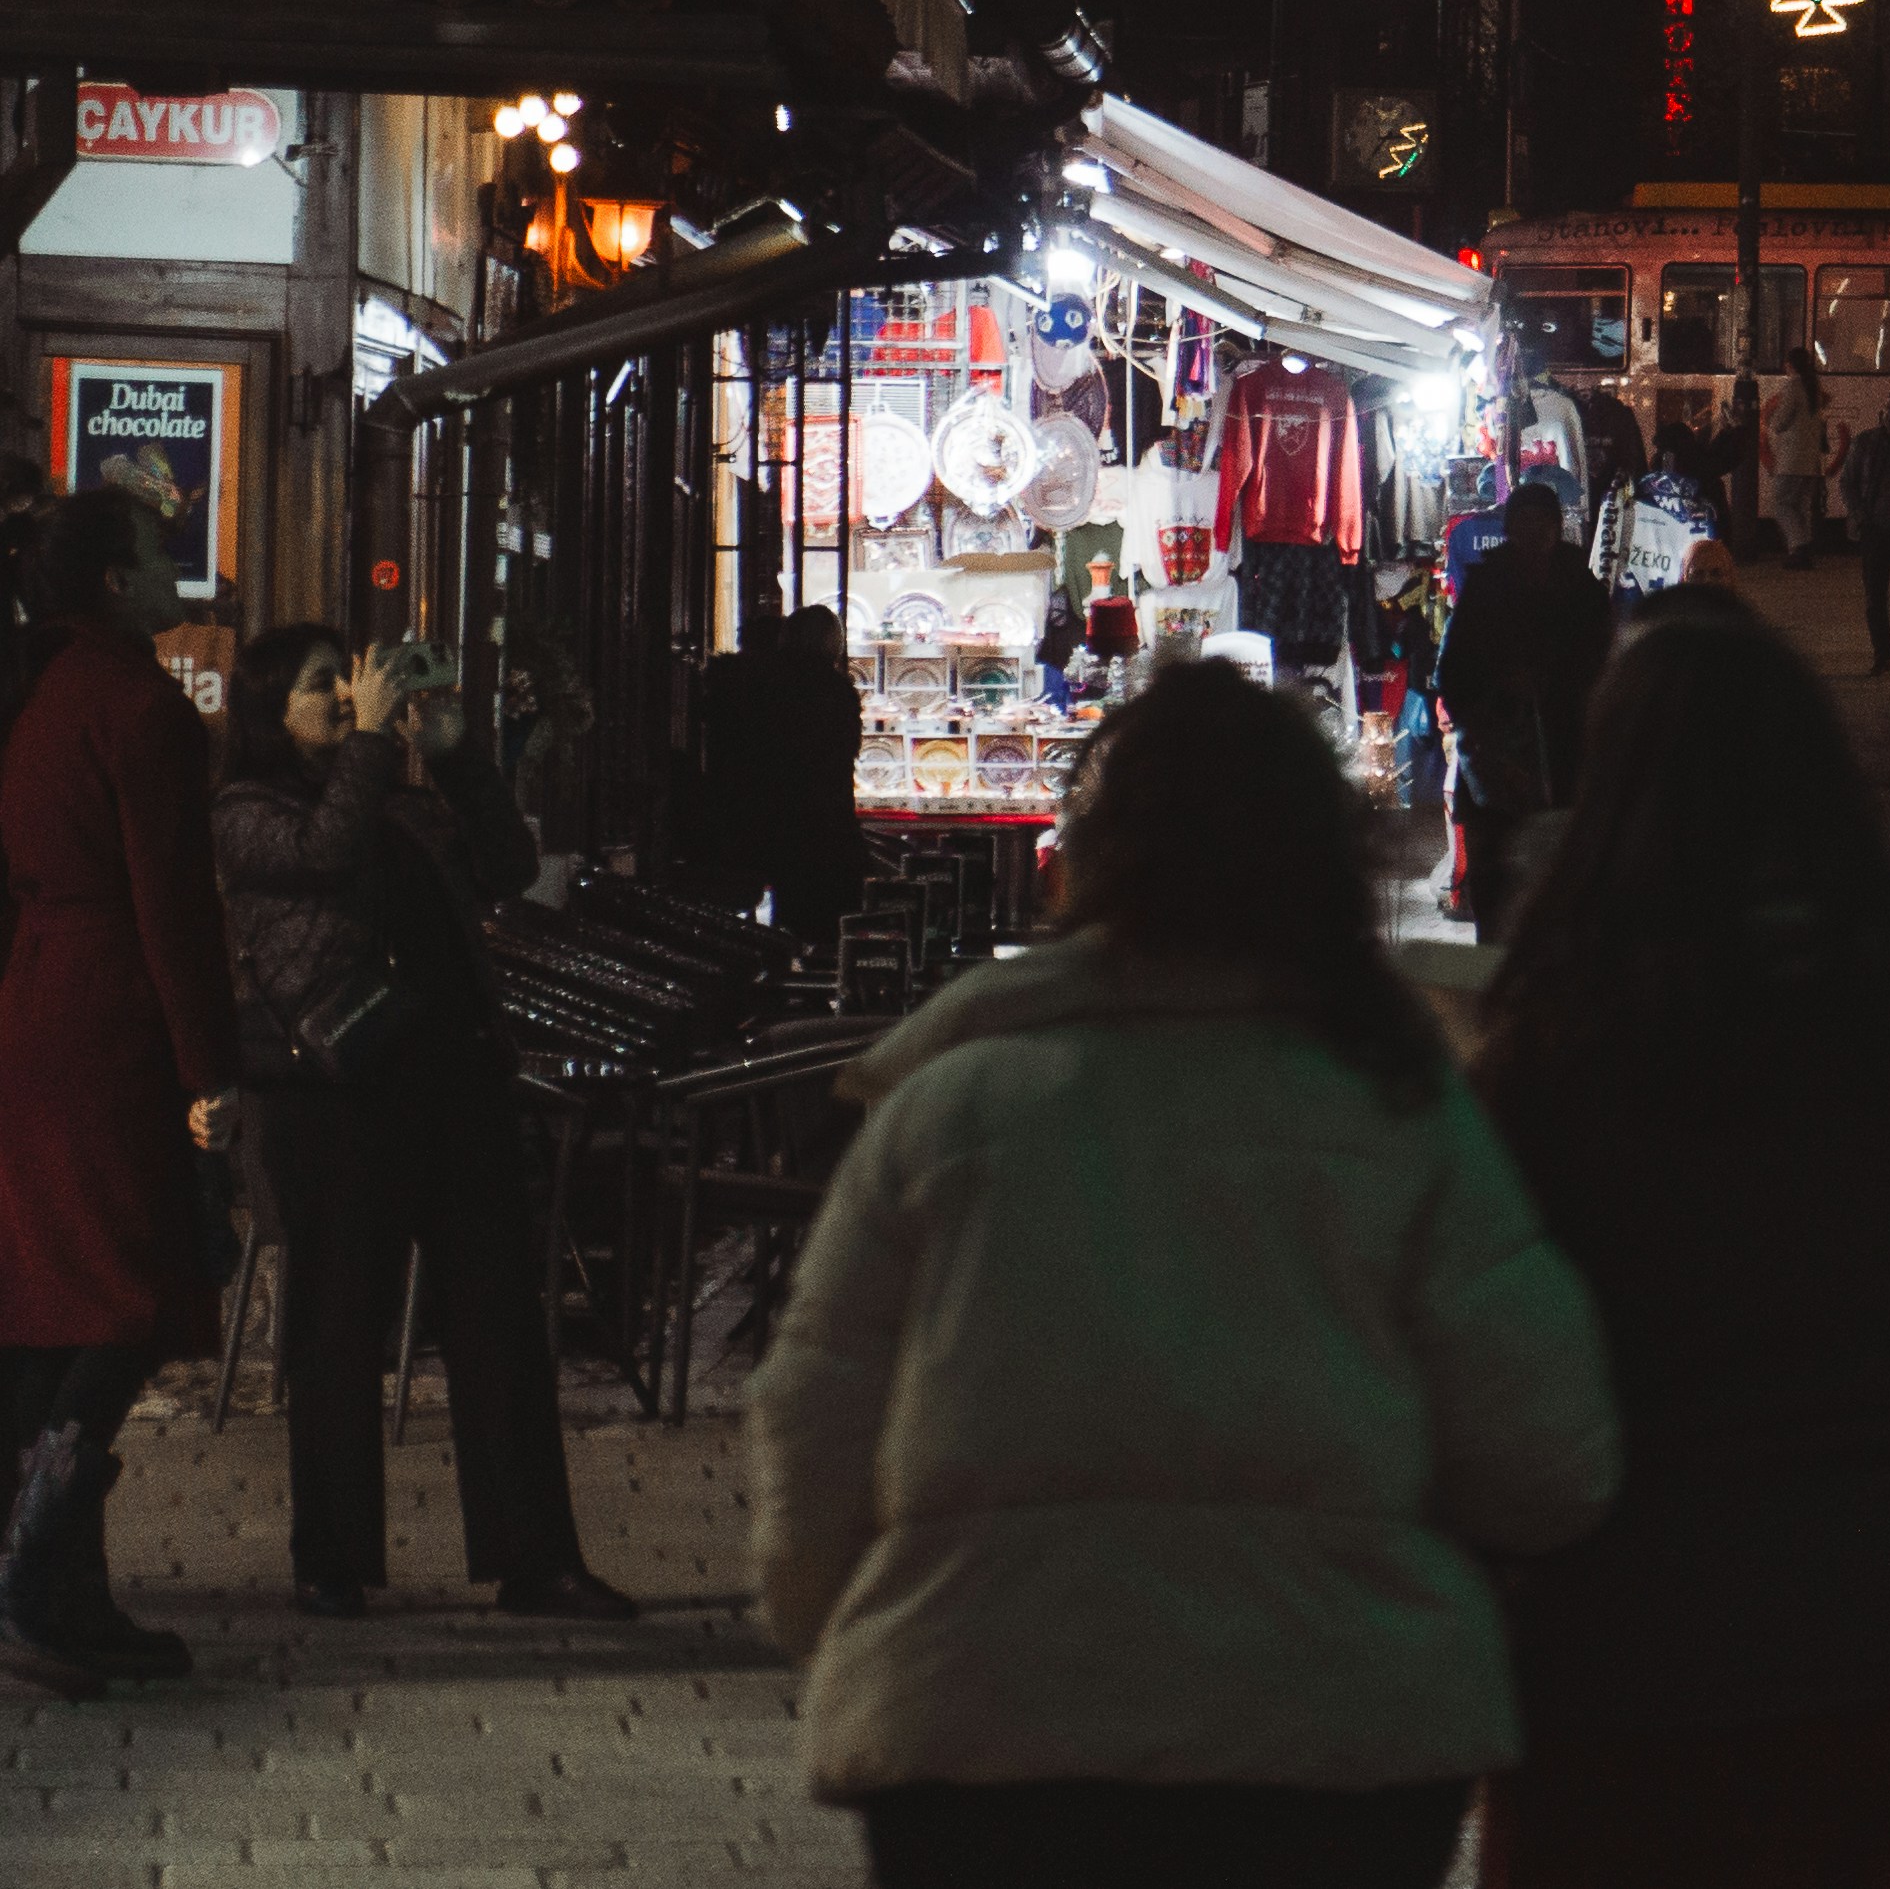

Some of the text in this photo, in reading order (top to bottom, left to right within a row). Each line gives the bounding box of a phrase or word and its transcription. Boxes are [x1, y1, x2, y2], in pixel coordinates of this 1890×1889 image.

[77, 99, 264, 149] ÇAYKUR
[108, 383, 186, 412] Dubai
[87, 409, 207, 439] chocolate
